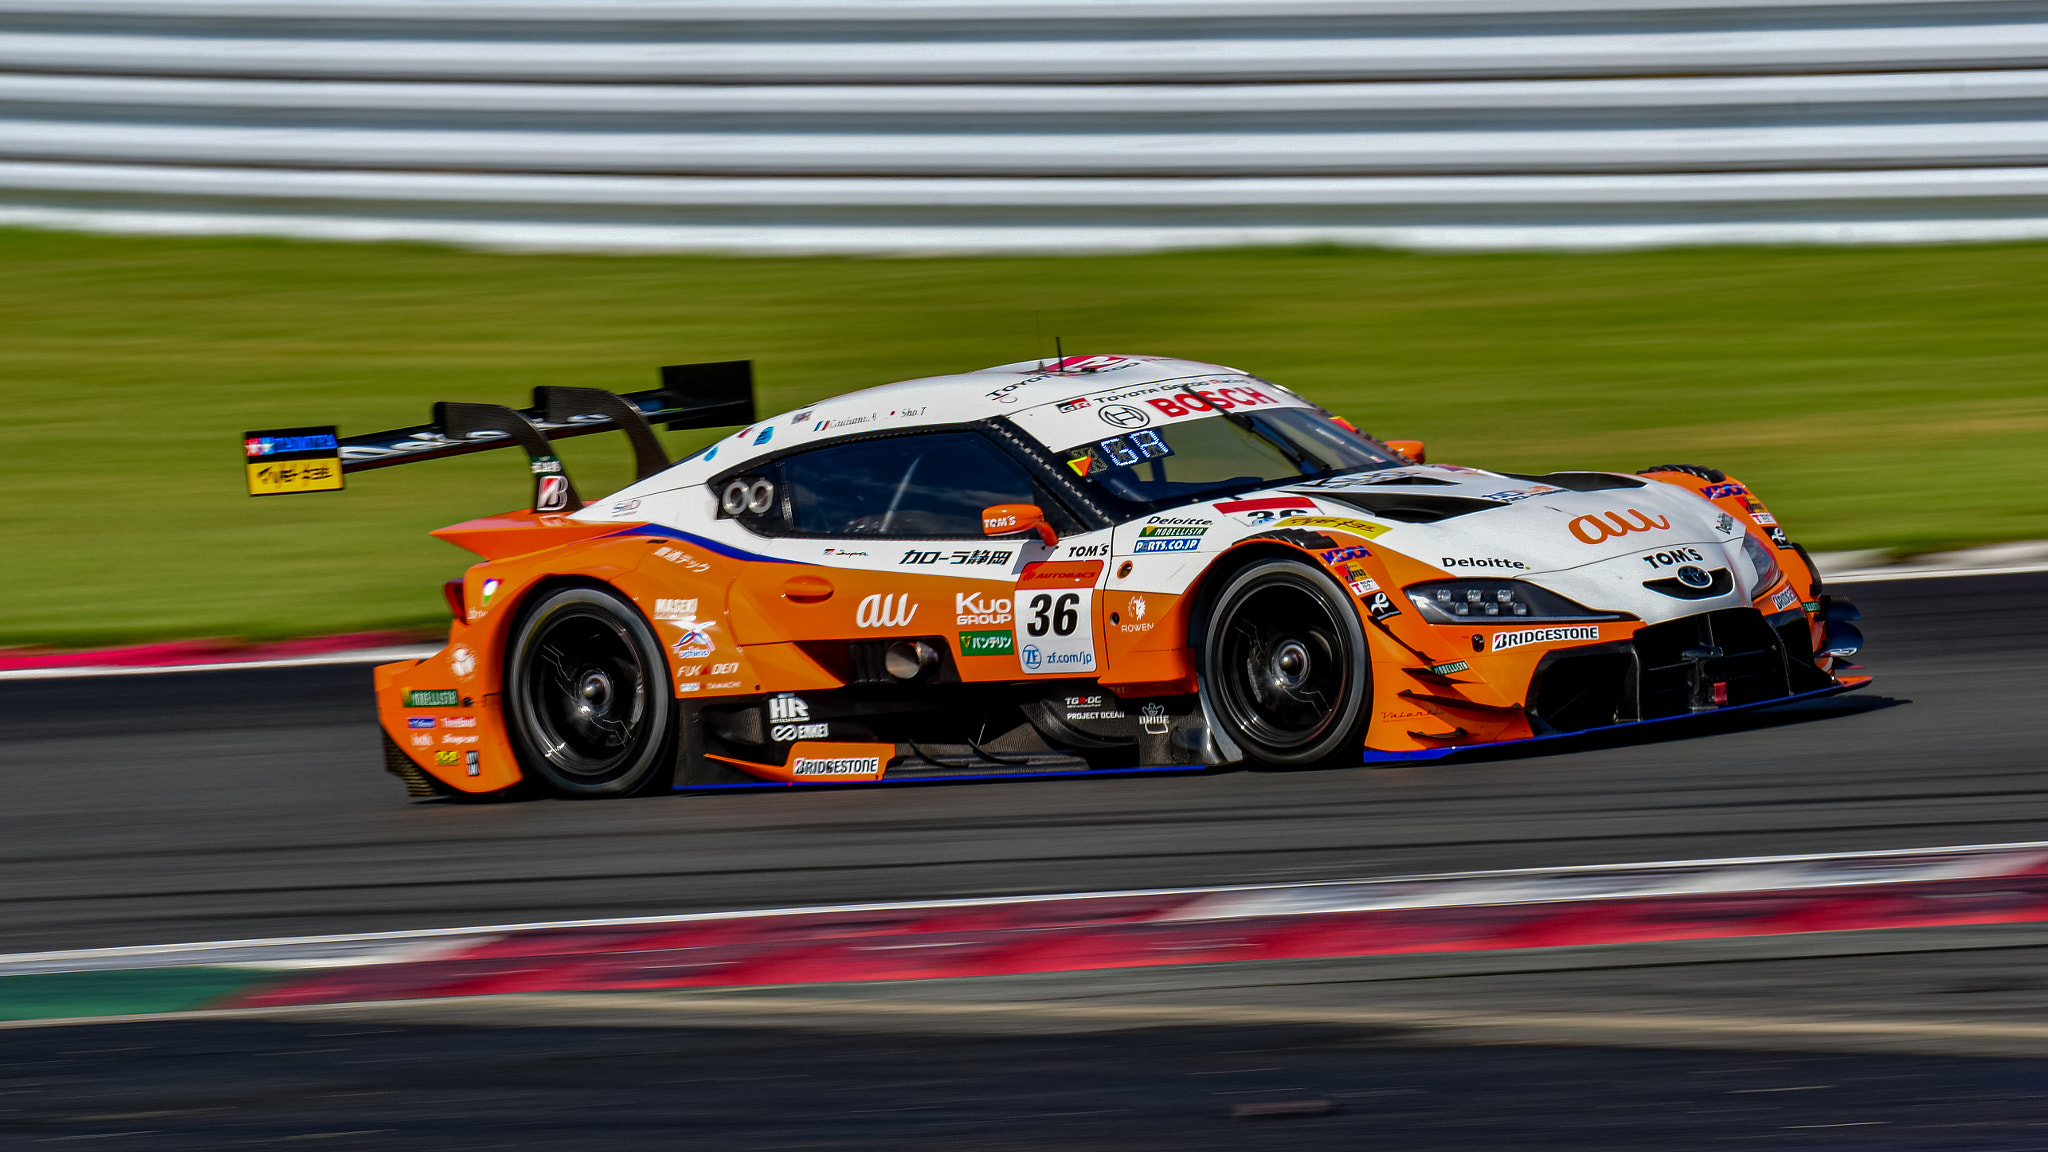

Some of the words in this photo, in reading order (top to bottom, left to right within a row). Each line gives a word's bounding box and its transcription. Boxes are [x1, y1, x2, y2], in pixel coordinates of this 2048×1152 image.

[1093, 388, 1158, 404] TOYOTA
[1146, 386, 1280, 418] BOSCH
[983, 515, 1017, 529] TOM'S
[1147, 516, 1214, 526] Deloitte.
[1568, 508, 1671, 545] au
[1154, 527, 1204, 536] MODELLISTA
[899, 549, 1014, 566] カローラ静岡
[1068, 543, 1110, 558] TOM'S
[1441, 556, 1531, 571] Deloitte.
[1642, 547, 1704, 570] TOM'S
[1035, 571, 1097, 580] AUTOBACS
[856, 593, 919, 629] au
[1026, 593, 1081, 638] 36
[956, 614, 1013, 626] GROUP
[1121, 622, 1154, 633] ROWEN
[972, 635, 1012, 649] バンテリン
[1493, 626, 1599, 651] BRIDGESTONE
[1047, 650, 1092, 664] zf.com/jp
[1066, 711, 1099, 720] PROJECT
[1101, 711, 1125, 719] OCEAN
[794, 757, 879, 775] BRIDGESTONE
